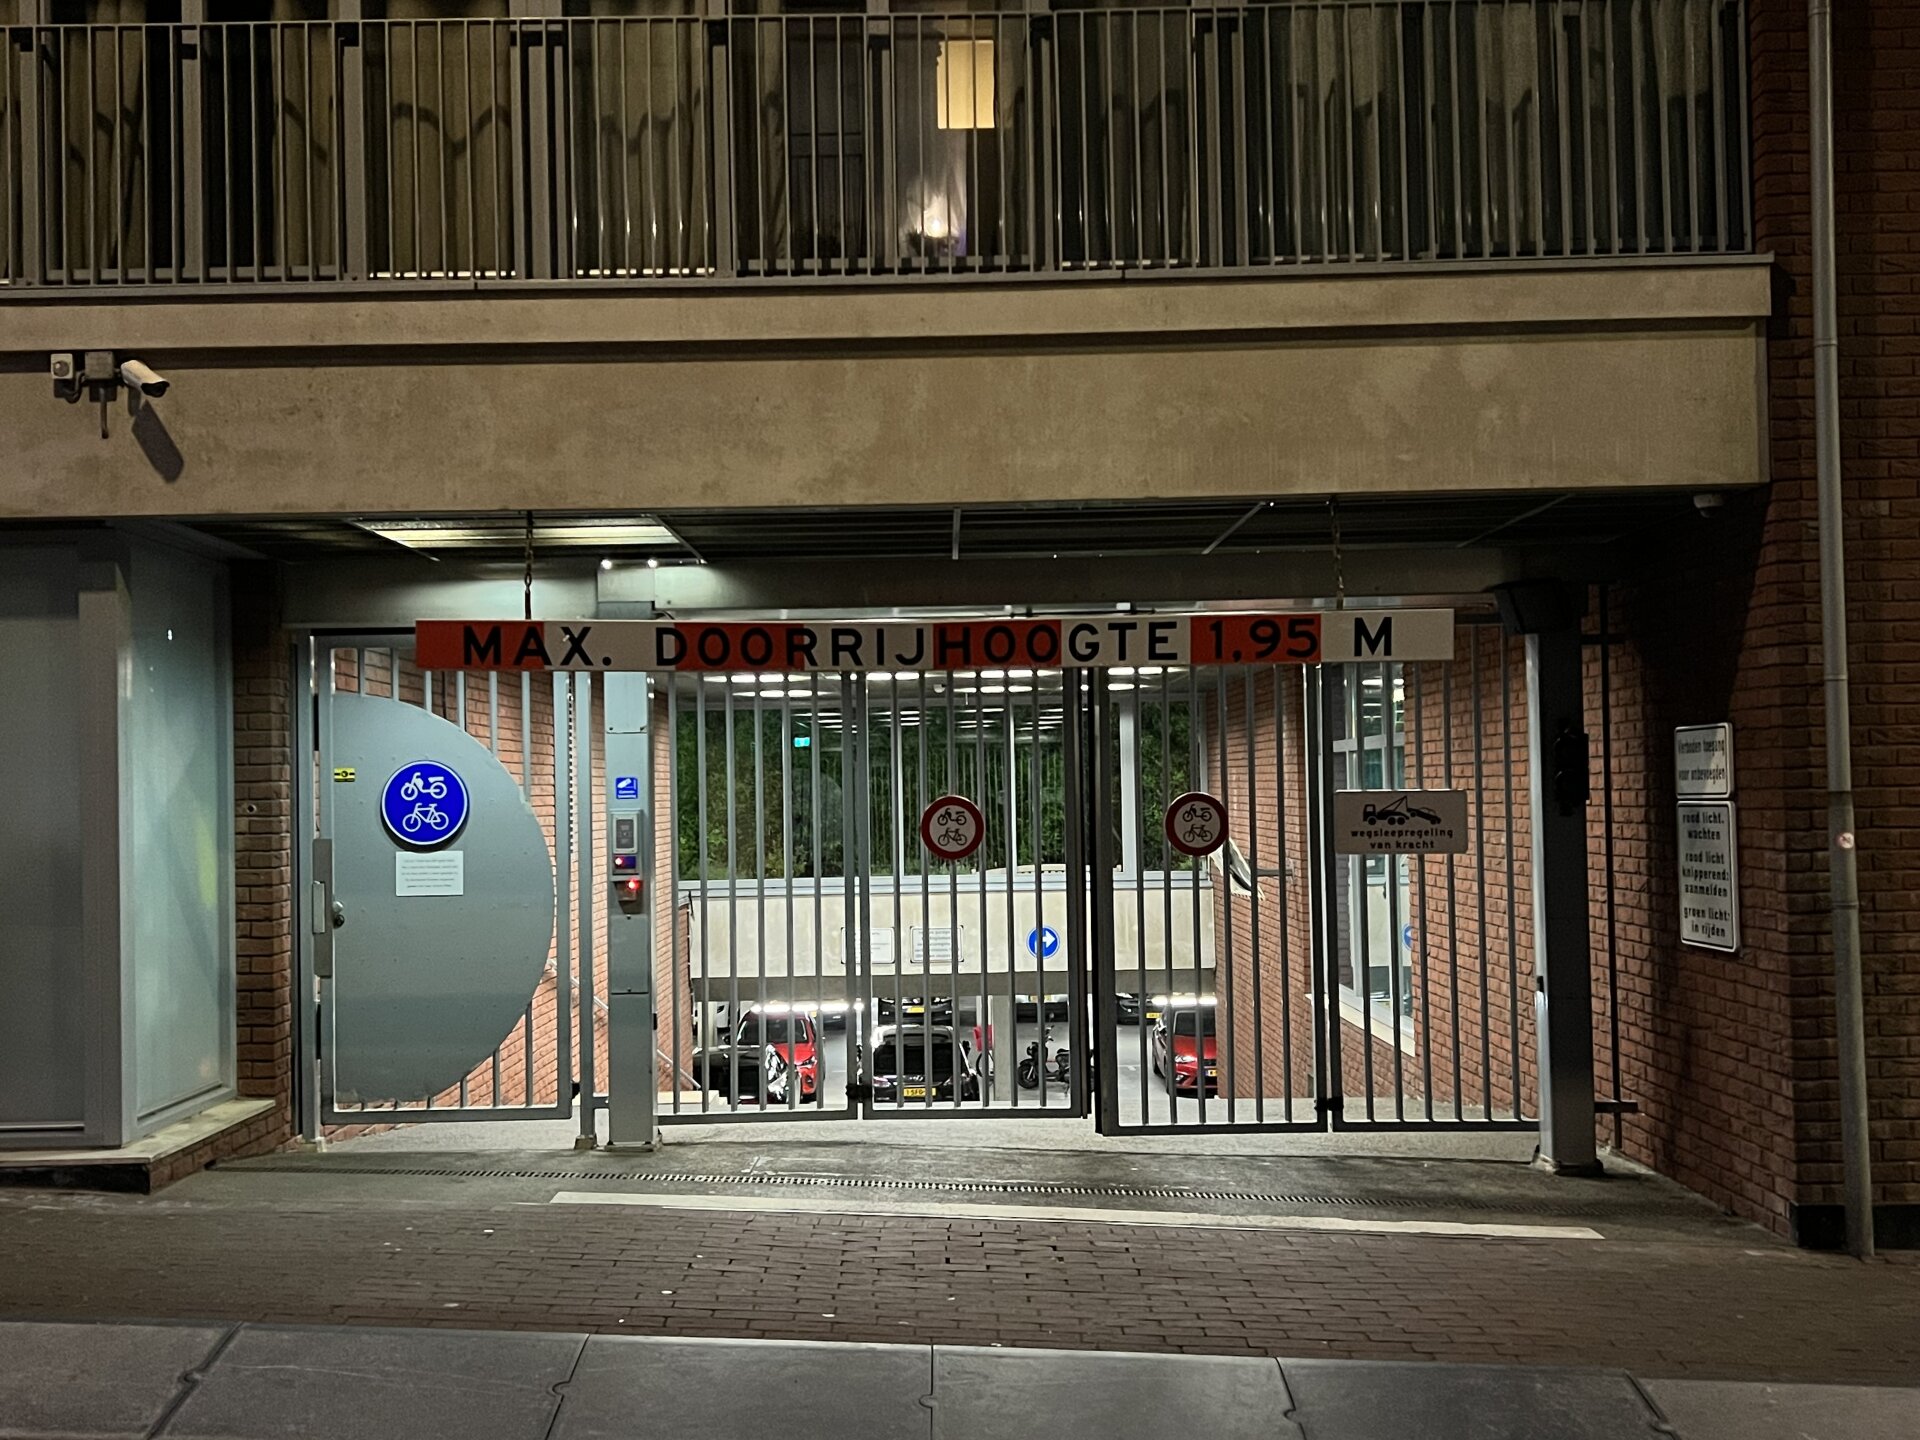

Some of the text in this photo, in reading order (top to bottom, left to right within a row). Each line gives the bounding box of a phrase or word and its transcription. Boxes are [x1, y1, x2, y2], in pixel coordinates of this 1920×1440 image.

[462, 625, 612, 667] MAX.
[656, 621, 1179, 667] DOORRIJHOOGTE
[1353, 616, 1393, 657] M
[1682, 811, 1700, 823] rood
[1350, 828, 1454, 839] wegsleepregeling
[1688, 827, 1721, 840] wachten
[1370, 840, 1435, 849] van kracht
[1685, 850, 1703, 863] rood
[1684, 883, 1728, 897] aanmelden
[1683, 907, 1706, 919] groen
[1691, 920, 1726, 938] in rijden
